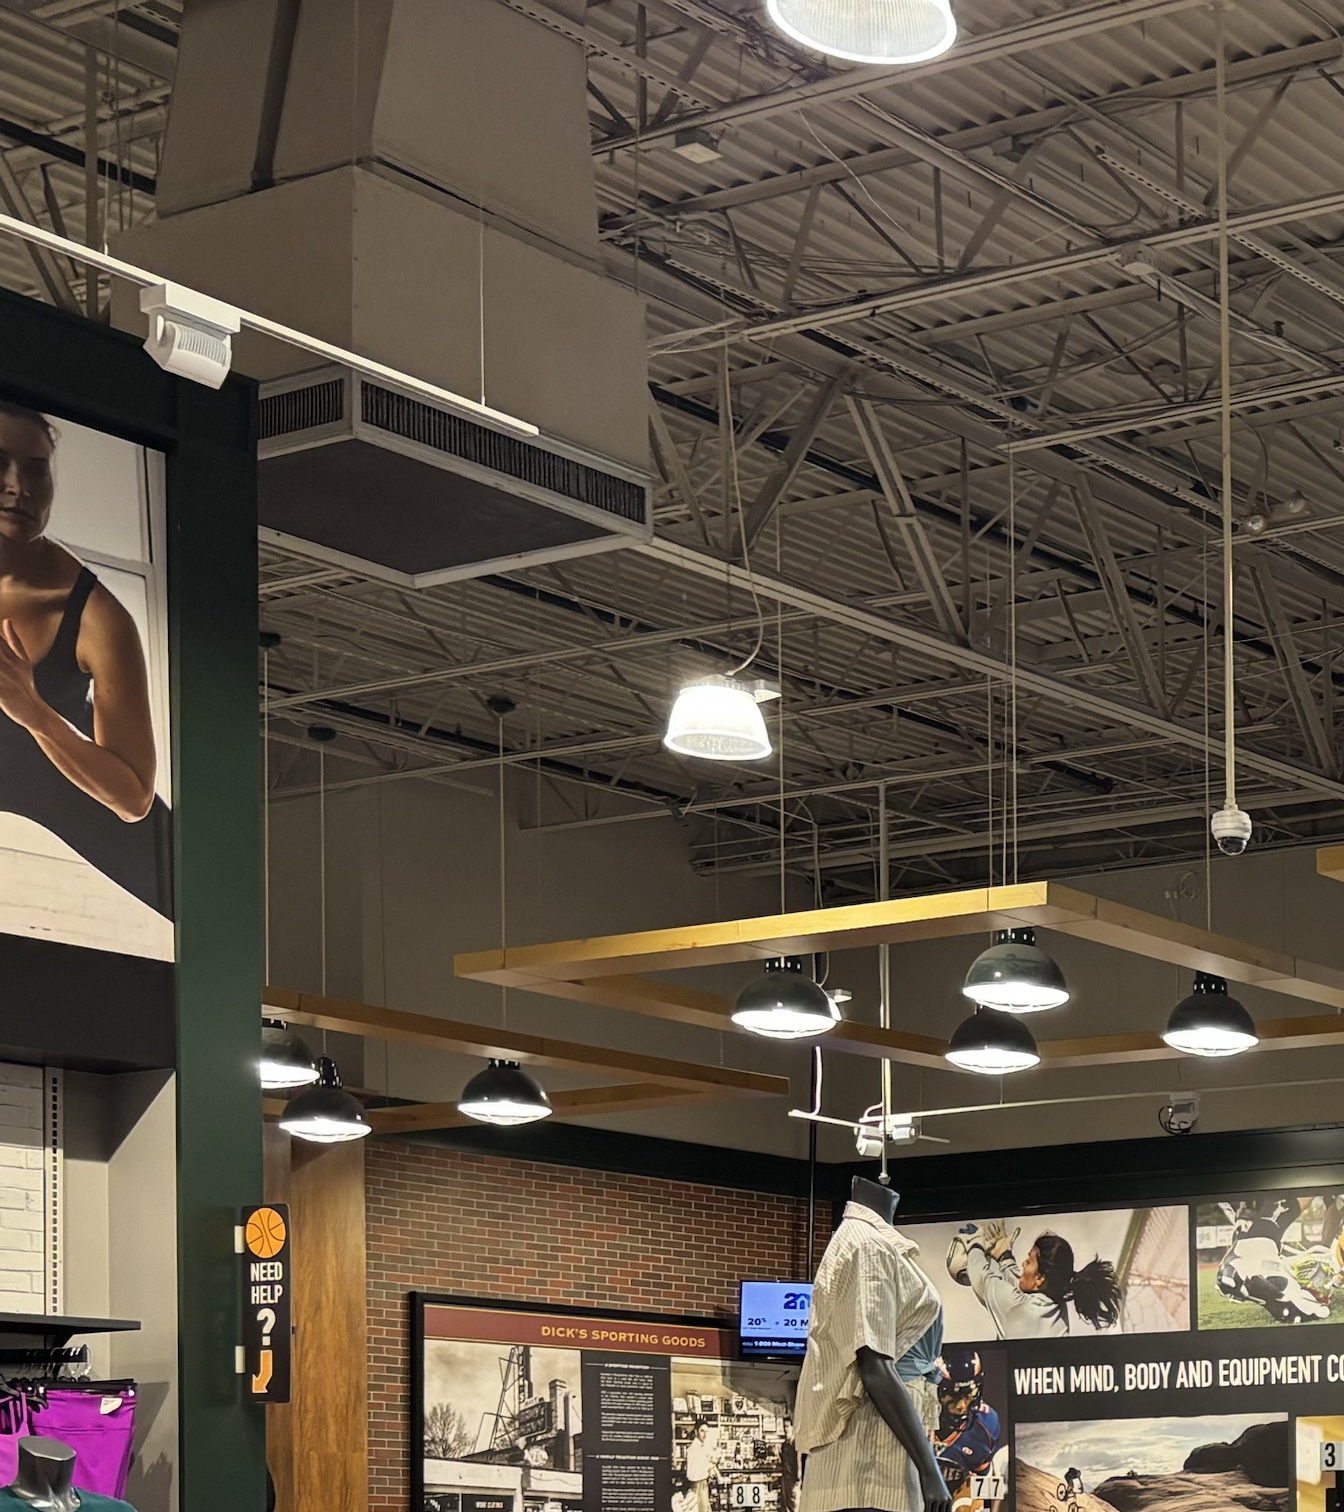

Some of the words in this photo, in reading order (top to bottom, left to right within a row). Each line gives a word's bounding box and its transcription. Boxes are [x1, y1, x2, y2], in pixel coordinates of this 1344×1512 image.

[250, 1262, 283, 1282] NEED
[250, 1284, 283, 1305] HELP
[541, 1325, 588, 1340] DICK'S
[591, 1329, 659, 1345] SPORTING
[662, 1335, 706, 1348] GOODS
[1014, 1366, 1065, 1395] WHEN
[1070, 1364, 1120, 1394] MIND,
[1124, 1361, 1172, 1391] BODY
[1175, 1359, 1213, 1389] AND
[1218, 1355, 1323, 1387] EQUIPMENT
[1324, 1442, 1336, 1468] 3
[736, 1485, 745, 1505] 8
[752, 1485, 760, 1505] 8
[975, 1478, 985, 1498] 7
[992, 1478, 1000, 1498] 7
